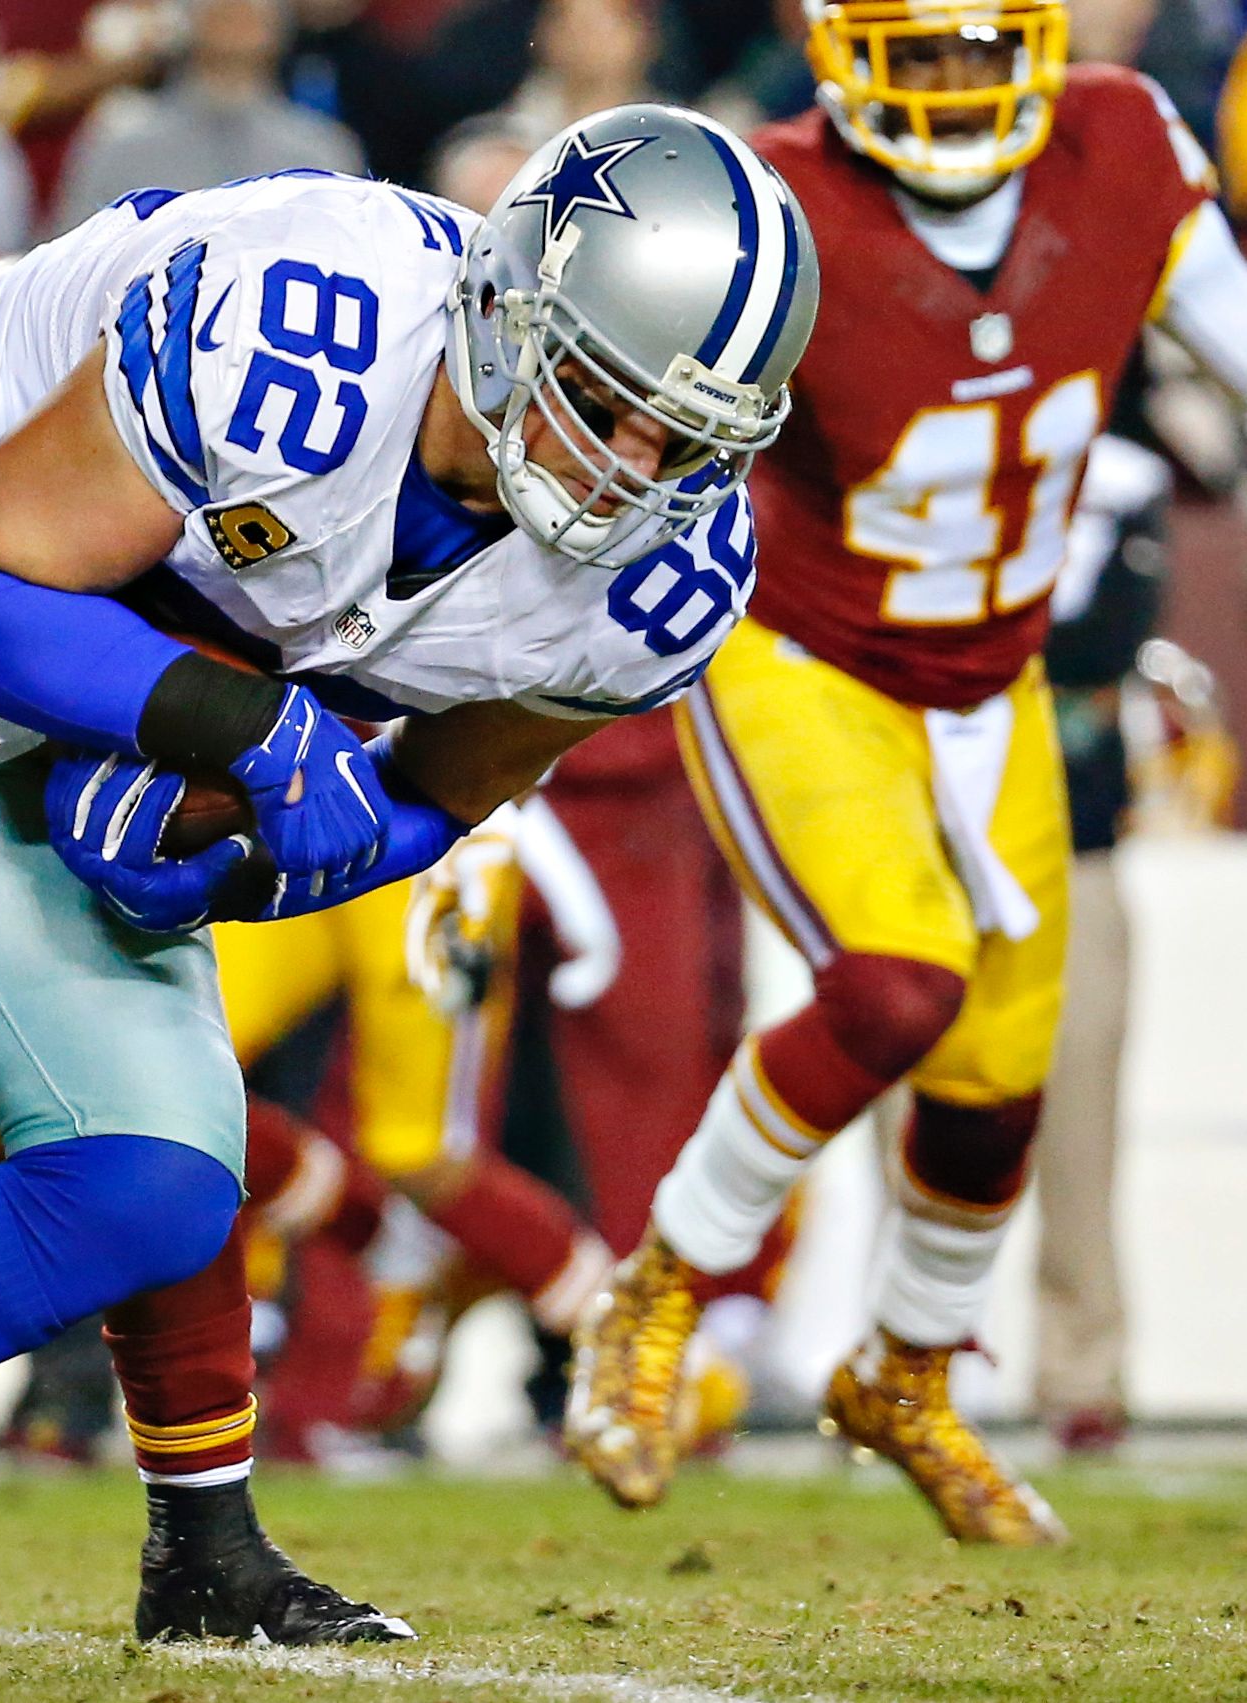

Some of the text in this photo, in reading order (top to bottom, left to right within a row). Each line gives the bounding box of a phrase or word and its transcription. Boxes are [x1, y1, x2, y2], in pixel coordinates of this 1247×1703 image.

[225, 258, 380, 477] 82
[693, 381, 738, 404] COWBOYS
[842, 366, 1102, 627] 41
[219, 505, 290, 560] C
[337, 614, 366, 648] NFL
